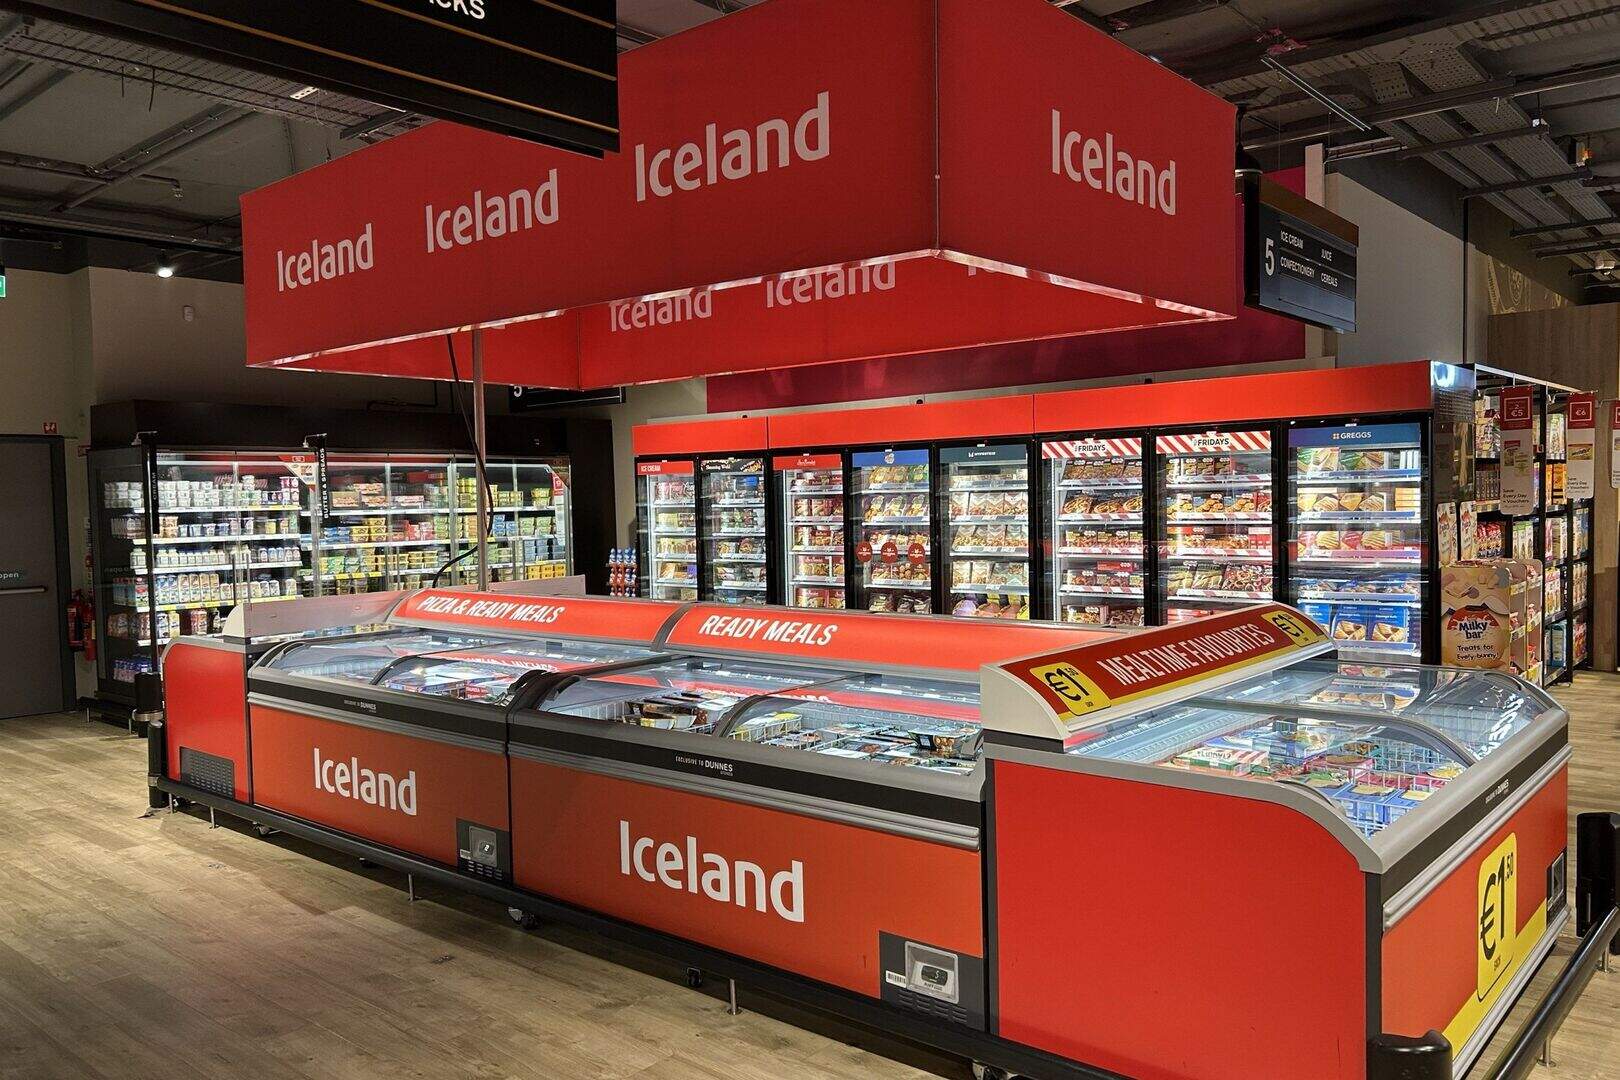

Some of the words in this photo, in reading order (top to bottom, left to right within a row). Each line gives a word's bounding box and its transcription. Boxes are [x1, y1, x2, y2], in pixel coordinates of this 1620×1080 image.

[634, 91, 831, 203] Iceland
[1051, 108, 1177, 217] Iceland
[425, 168, 560, 254] Iceland
[1280, 230, 1289, 244] ICE
[1289, 232, 1304, 250] CREAM
[277, 222, 374, 293] Iceland
[1265, 237, 1275, 276] 5
[1280, 256, 1315, 279] CONFECTIONERY
[766, 261, 896, 308] Iceland
[1320, 272, 1339, 288] CEREALS
[608, 288, 713, 333] Iceland
[1077, 444, 1106, 452] FRIDAYS
[1197, 437, 1230, 446] FRIDAYS
[1340, 431, 1372, 440] GREGGS
[322, 490, 330, 519] BUTTER
[416, 595, 455, 614] PIZZA
[455, 598, 471, 615] &
[466, 599, 518, 619] READY
[509, 604, 566, 624] MEALS
[699, 614, 769, 639] READY
[762, 620, 838, 646] MEALS
[1458, 620, 1487, 631] Milky
[1465, 630, 1483, 639] bar
[1096, 640, 1200, 686] MEALTIME
[1178, 623, 1275, 664] FAVOURITES
[675, 755, 697, 765] EXCLUSIVE
[704, 760, 733, 772] DUNNES
[313, 747, 417, 816] Iceland
[620, 820, 805, 923] Iceland
